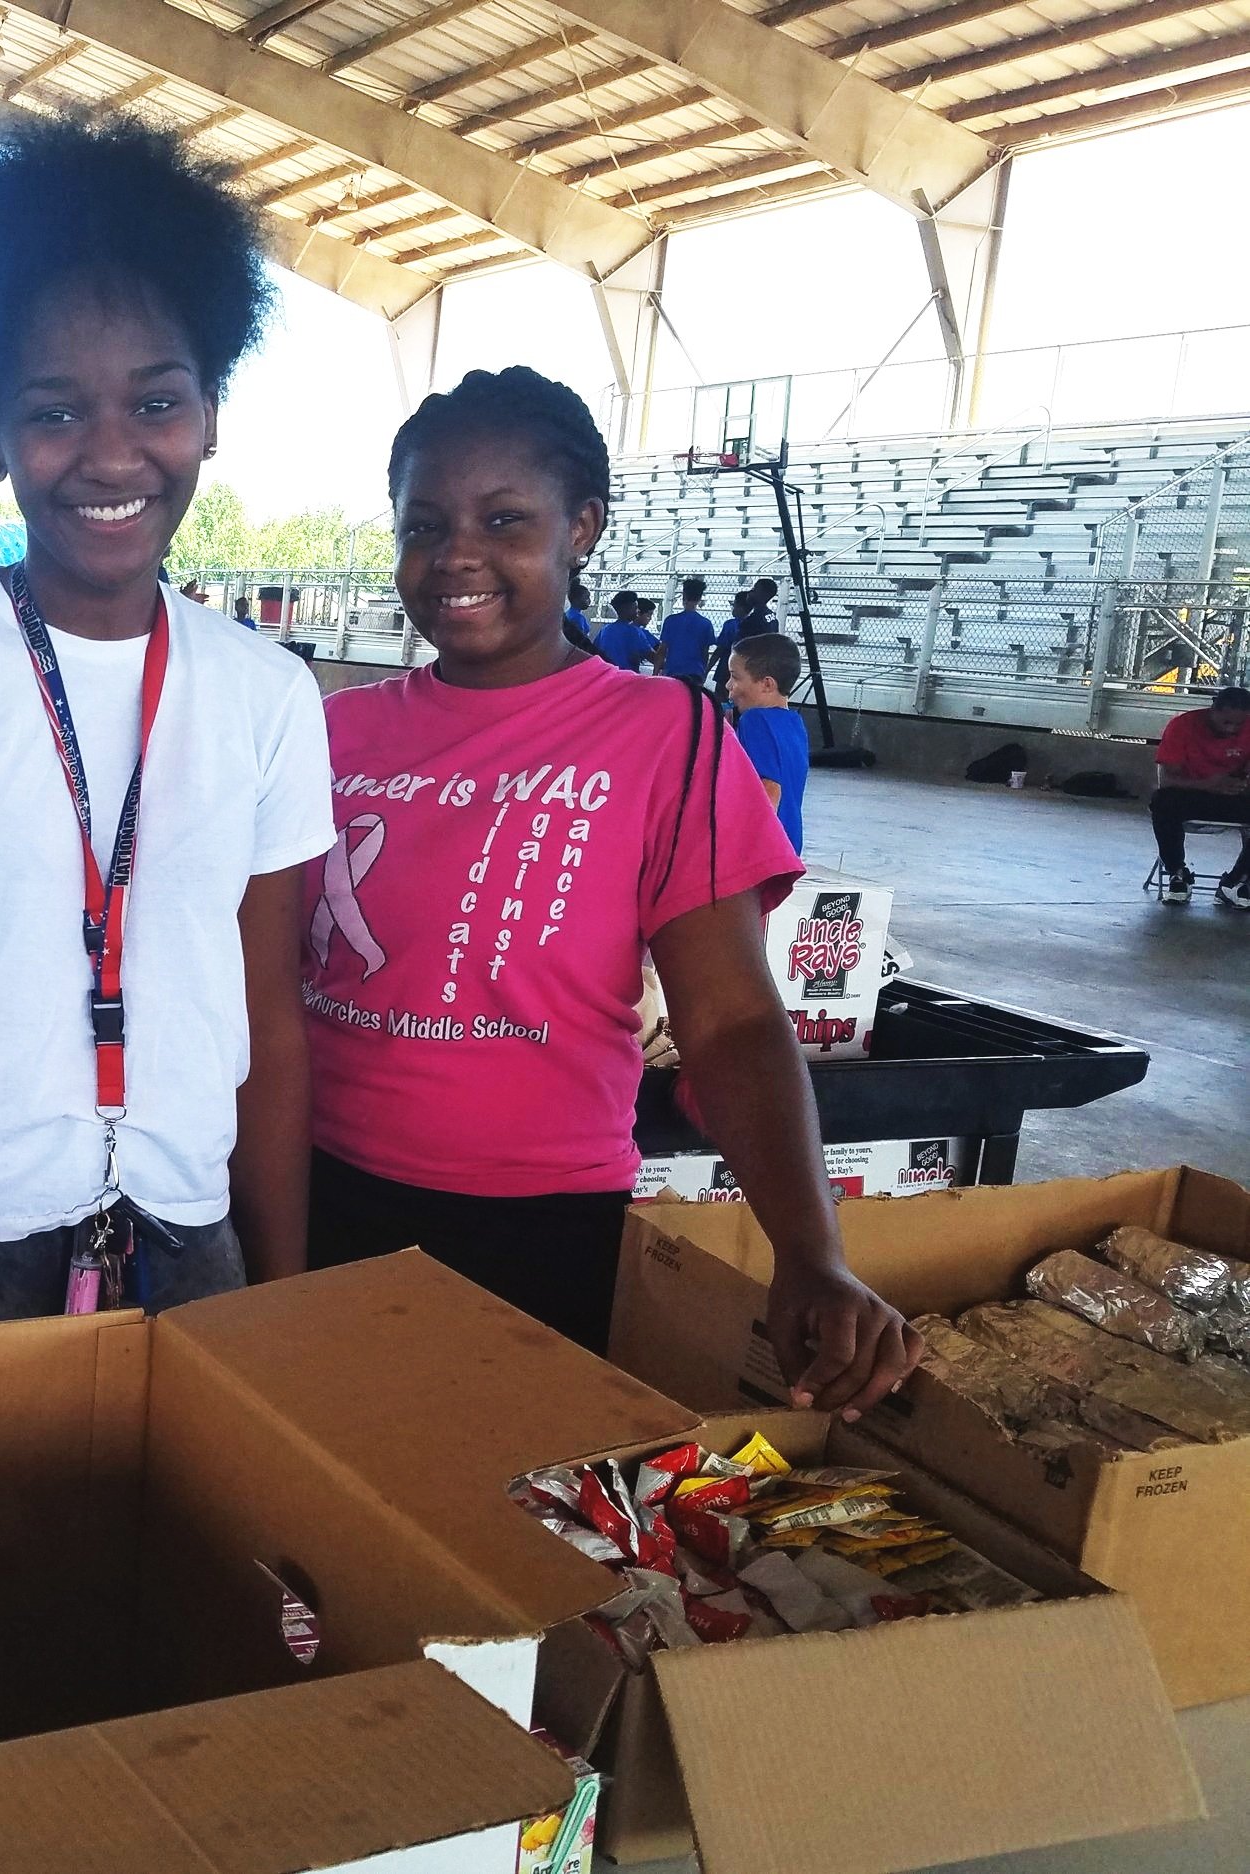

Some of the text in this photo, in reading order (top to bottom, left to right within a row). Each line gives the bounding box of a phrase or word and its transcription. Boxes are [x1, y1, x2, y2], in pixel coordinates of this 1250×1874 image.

[59, 728, 88, 807] NATIONAL
[438, 772, 477, 807] is
[492, 763, 611, 812] WAC
[113, 809, 139, 887] NATIONAL
[821, 895, 851, 913] BEYOND
[387, 1008, 464, 1041] Middle
[471, 1014, 549, 1045] School
[786, 1008, 858, 1053] hips
[845, 1156, 869, 1166] choosing
[916, 1142, 940, 1161] BEYOND
[644, 1246, 683, 1272] FROZEN
[1149, 1465, 1183, 1481] KEEP
[1136, 1479, 1188, 1498] FROZEN
